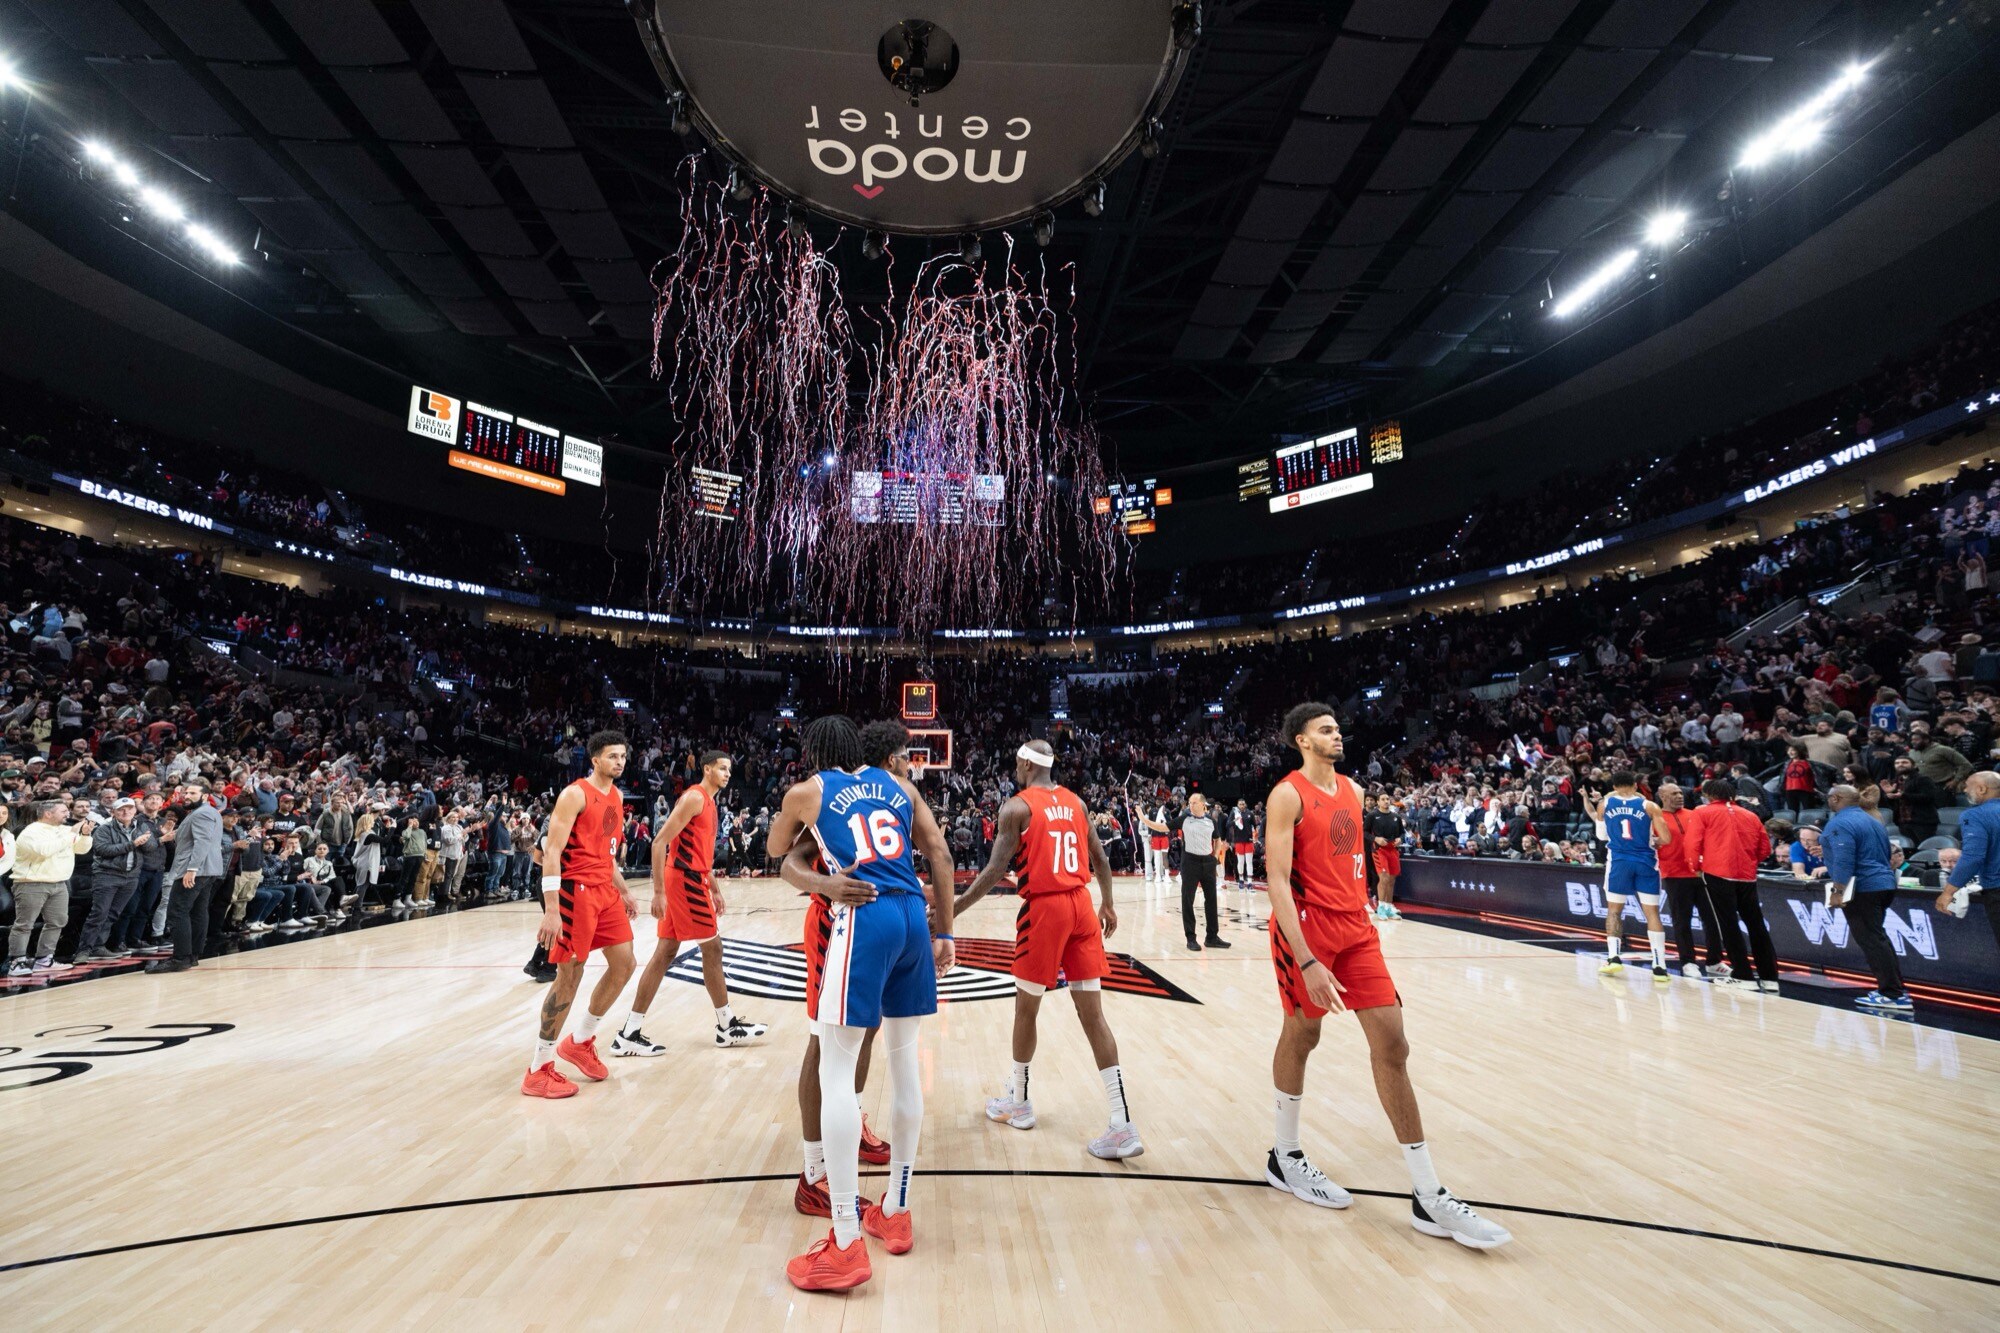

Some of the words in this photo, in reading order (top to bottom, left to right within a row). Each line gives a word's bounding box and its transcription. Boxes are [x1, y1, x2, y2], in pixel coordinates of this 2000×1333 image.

[805, 105, 1031, 141] center
[807, 138, 1027, 187] moda
[415, 422, 451, 438] BRUUN
[416, 415, 452, 431] LORENTZ
[1371, 427, 1401, 441] ripcity
[1371, 435, 1401, 449] ripcity
[1372, 451, 1403, 464] ripcity
[564, 462, 583, 472] DRINK
[584, 468, 600, 478] BEER
[1744, 459, 1827, 503] BLAZERS
[1830, 438, 1876, 465] WIN
[80, 479, 171, 517] BLAZERS
[177, 508, 213, 530] WIN
[1506, 549, 1570, 575] BLAZERS
[1573, 538, 1604, 556] WIN
[390, 568, 453, 590] BLAZERS
[457, 581, 485, 595] WIN
[591, 606, 644, 620] BLAZERS
[647, 612, 670, 623] WIN
[1286, 602, 1337, 619] BLAZERS
[1340, 596, 1366, 609] WIN
[789, 626, 835, 636] BLAZERS
[839, 627, 860, 636] WIN
[944, 629, 989, 638] BLAZERS
[992, 629, 1013, 637] WIN
[1123, 622, 1170, 635] BLAZERS
[1172, 620, 1194, 630] WIN
[913, 687, 926, 695] 0.0
[613, 701, 629, 709] WIN
[829, 783, 885, 815] COUNCIL
[890, 793, 907, 809] IV
[1044, 805, 1074, 822] MOORE
[1605, 807, 1633, 819] MARTIN
[847, 809, 905, 864] 16
[1621, 819, 1633, 840] 1
[610, 837, 616, 855] 3
[1048, 831, 1079, 874] 76
[1787, 899, 1939, 960] WN
